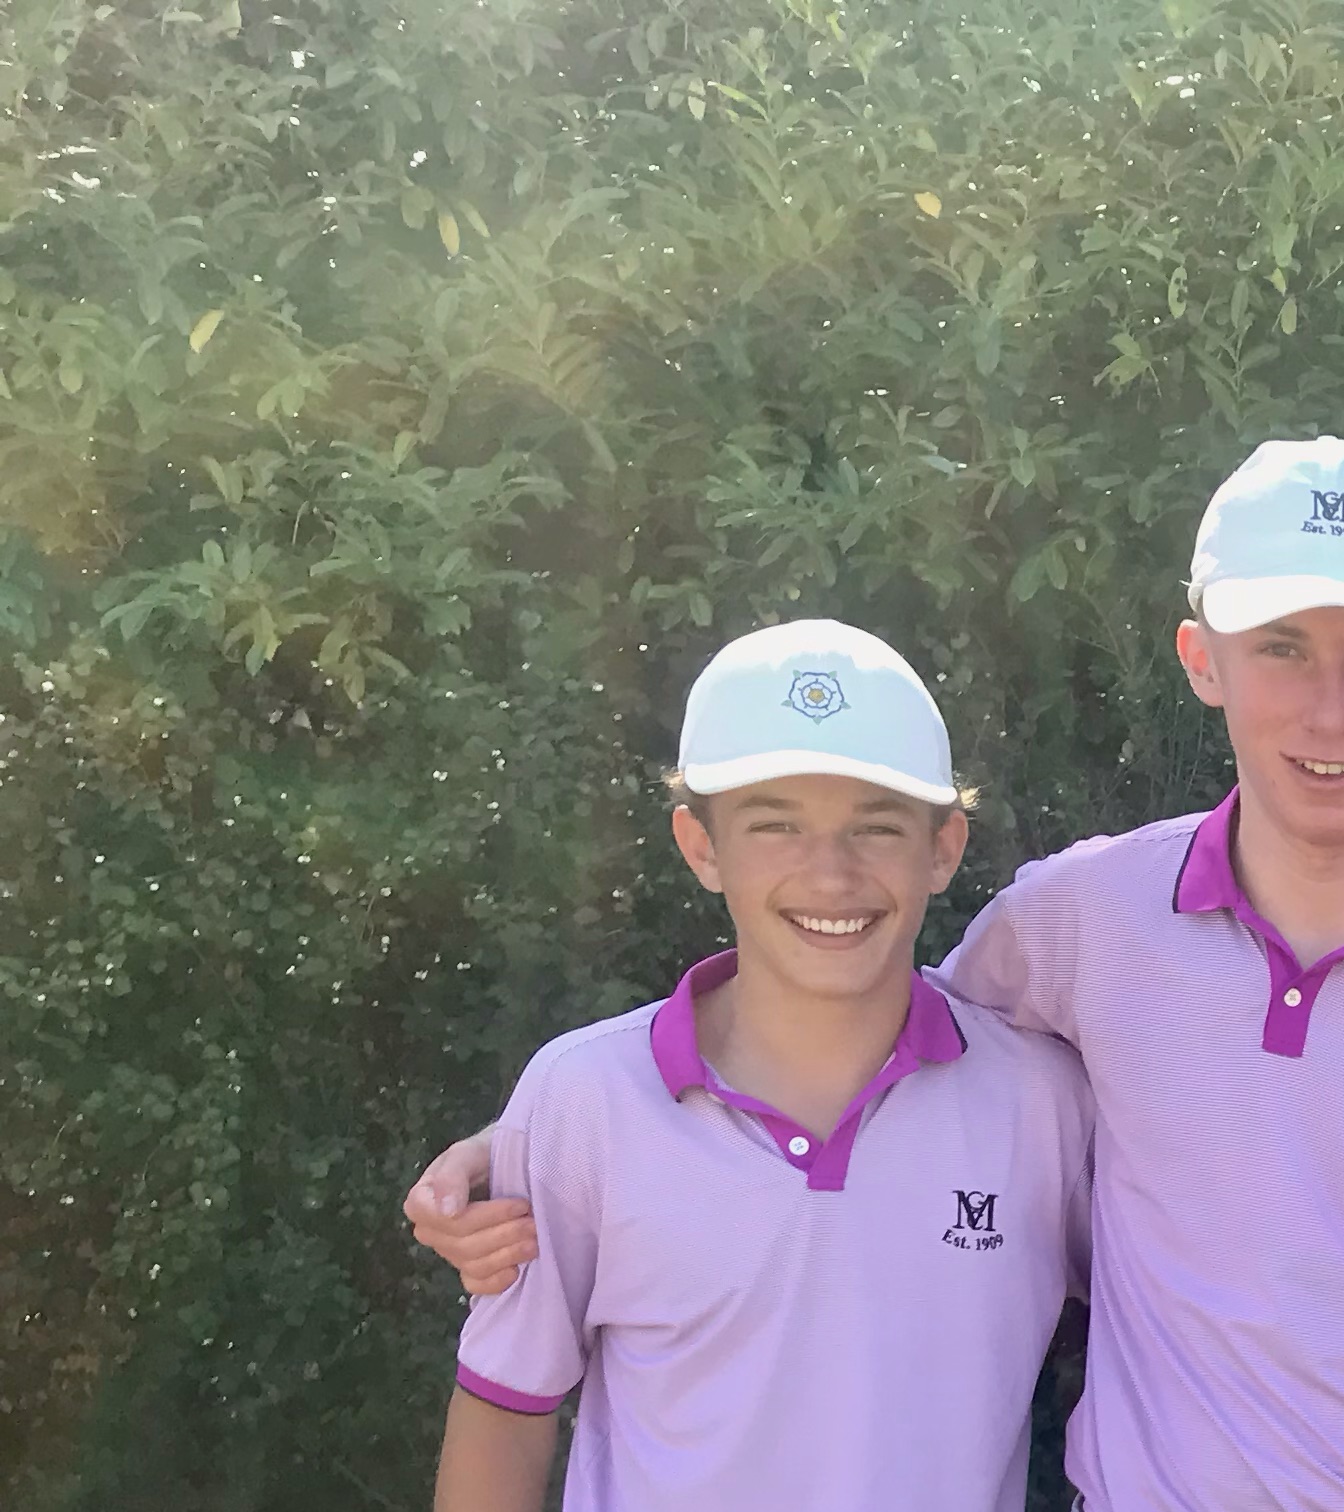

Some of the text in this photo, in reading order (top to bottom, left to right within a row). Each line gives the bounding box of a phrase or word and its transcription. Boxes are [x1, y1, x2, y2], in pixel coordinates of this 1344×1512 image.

[1301, 521, 1327, 534] Est.
[942, 1229, 1004, 1251] Est. 1909
